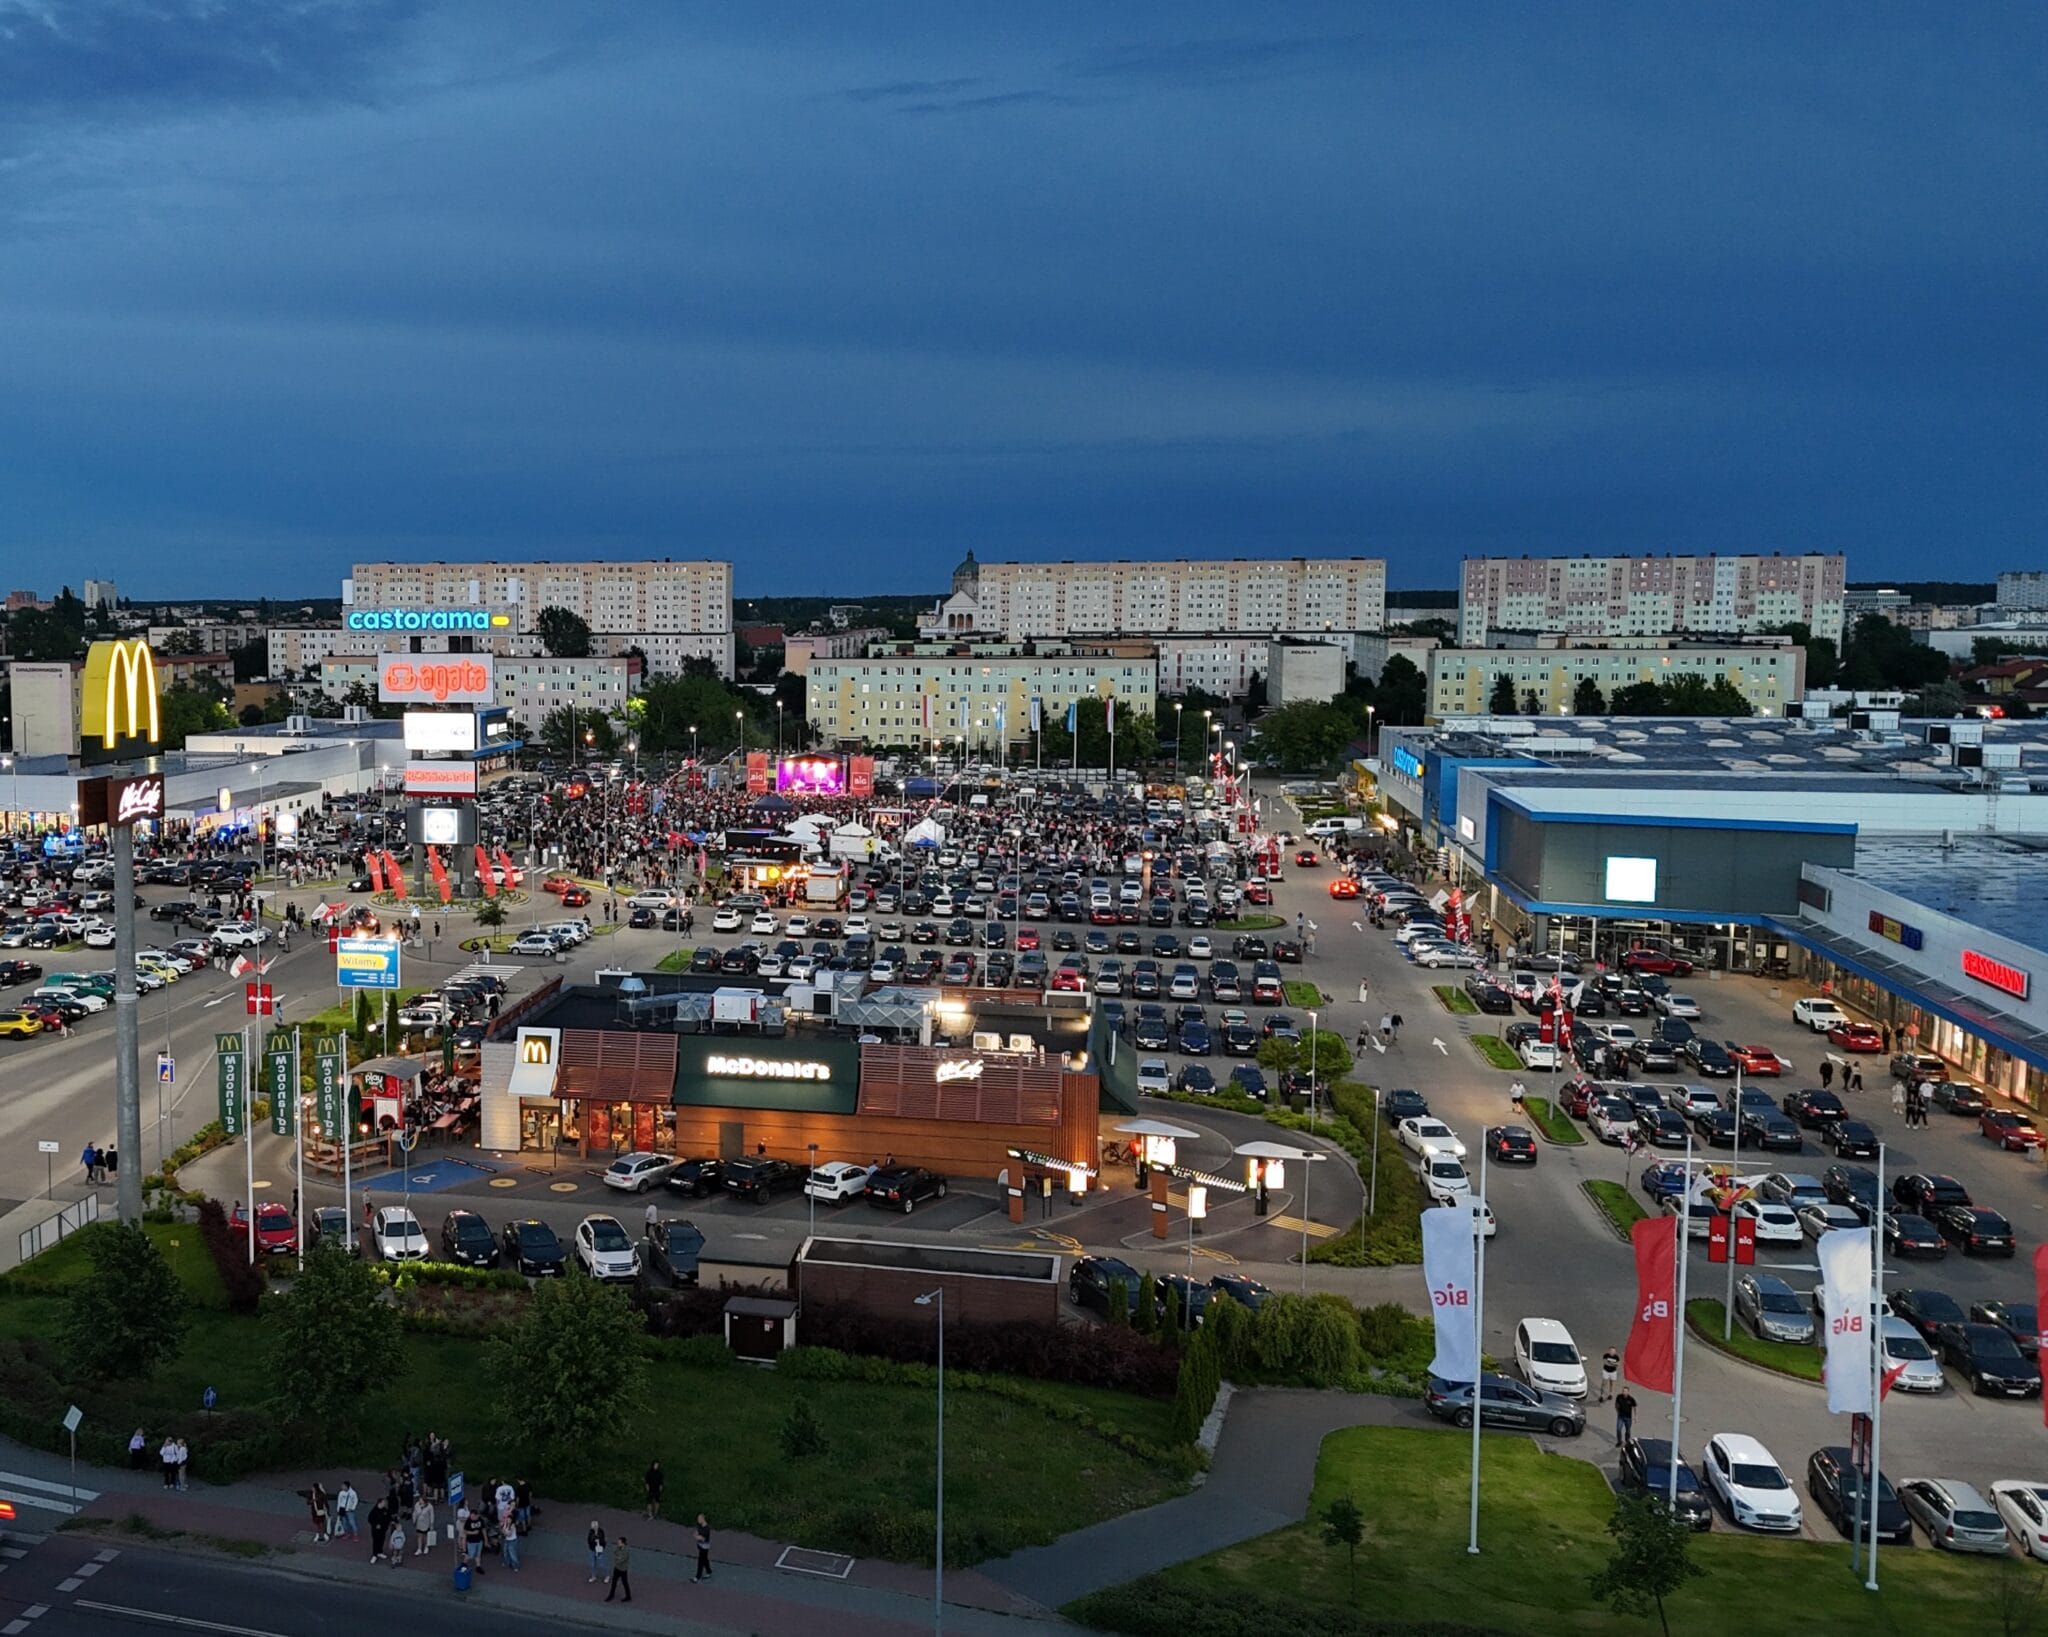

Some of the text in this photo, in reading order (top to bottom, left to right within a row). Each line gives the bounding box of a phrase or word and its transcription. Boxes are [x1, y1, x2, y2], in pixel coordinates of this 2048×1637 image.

[348, 609, 490, 630] castorama
[420, 661, 487, 700] agata
[1963, 950, 2024, 995] ROSSMANN
[707, 1055, 831, 1080] McDonald's
